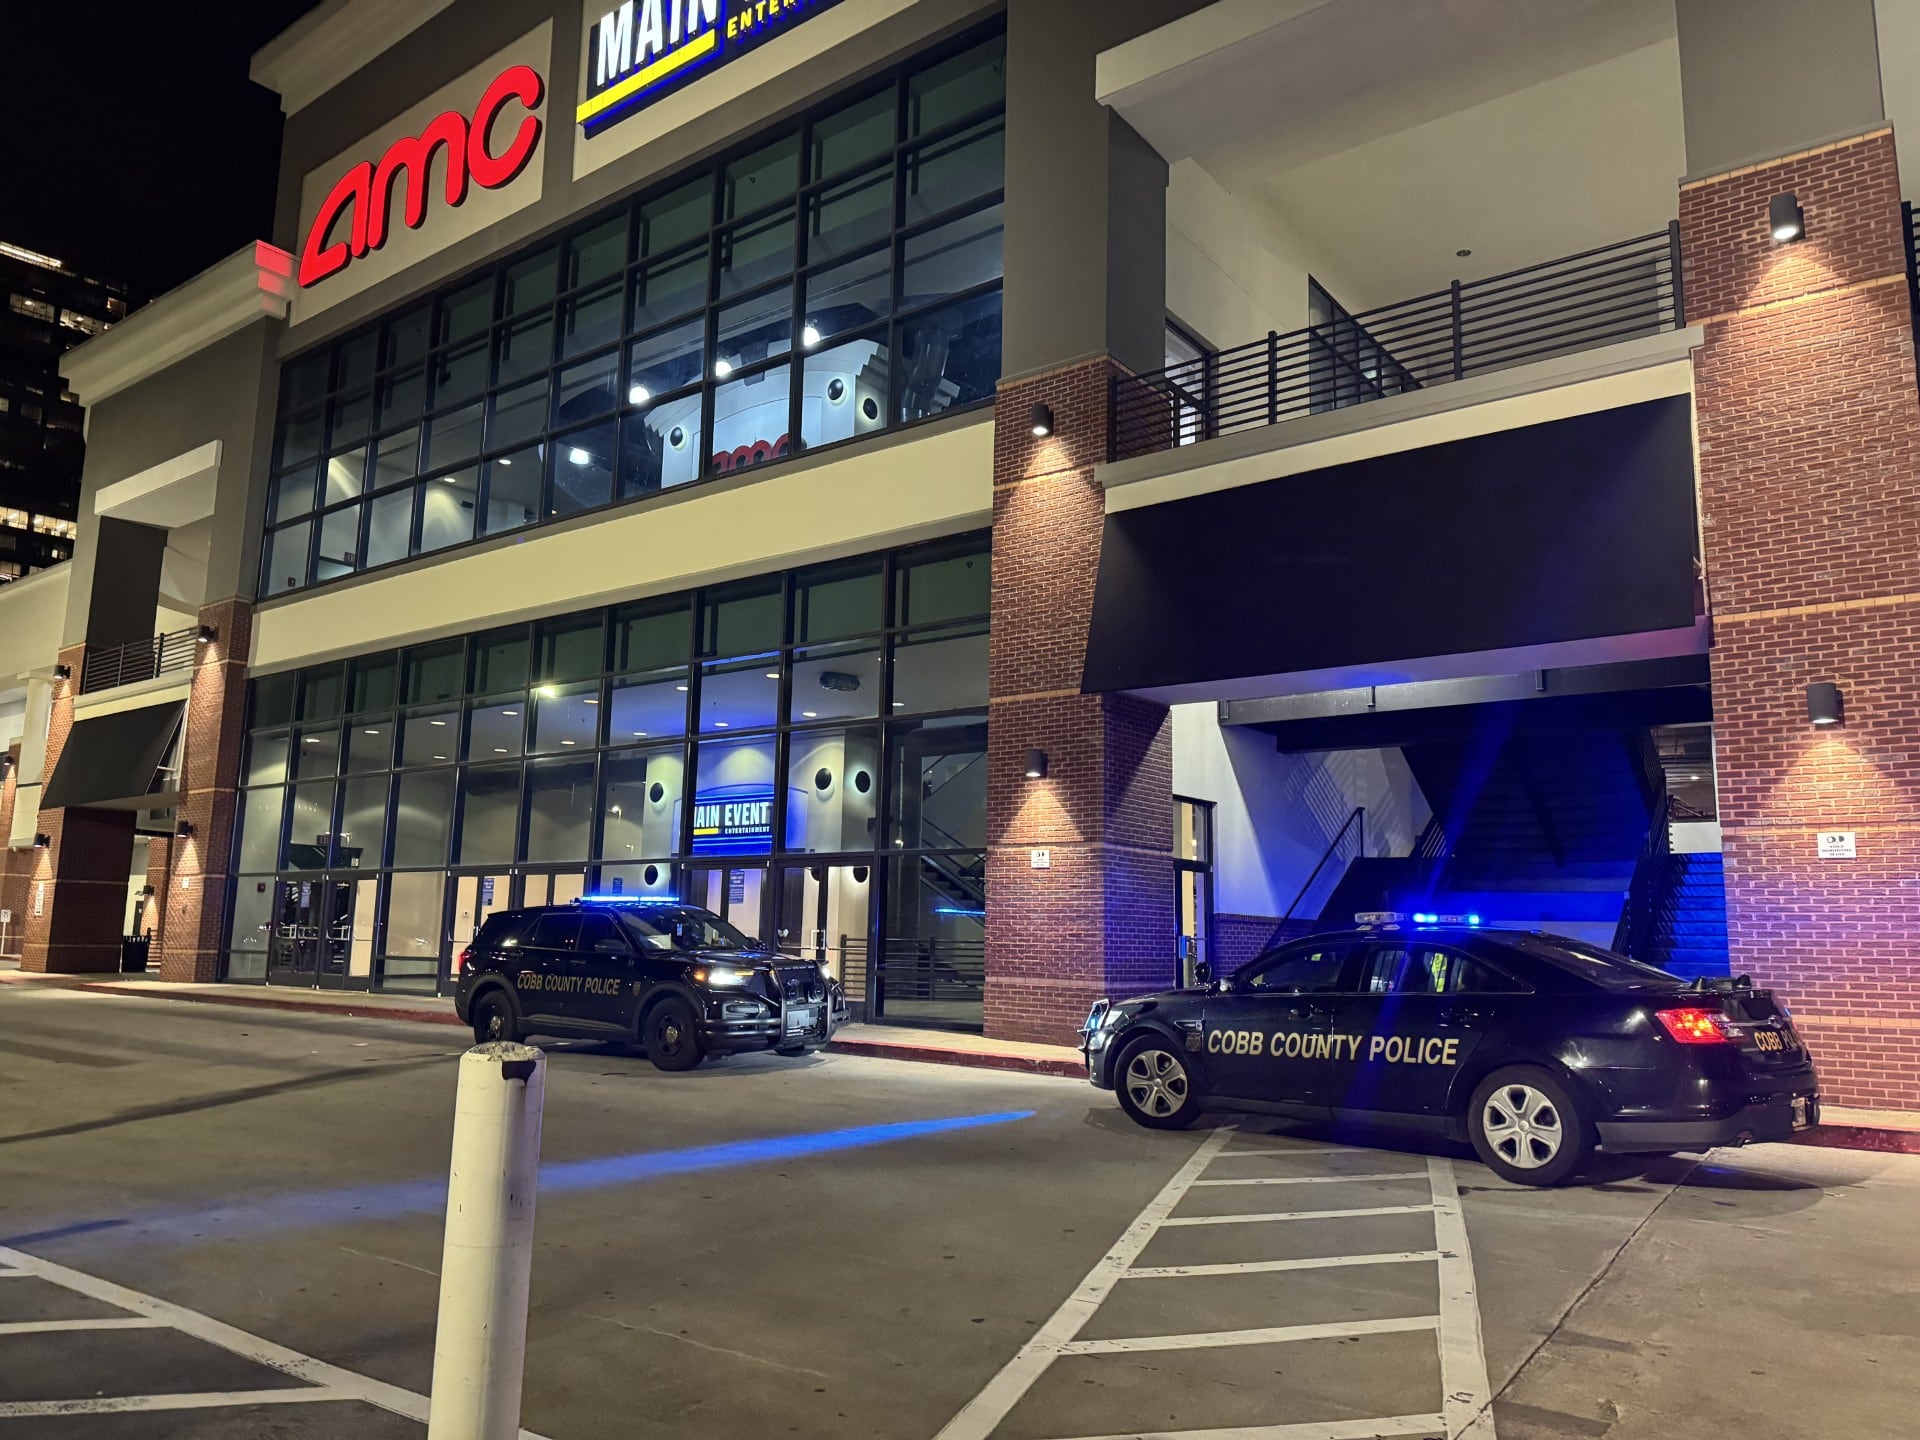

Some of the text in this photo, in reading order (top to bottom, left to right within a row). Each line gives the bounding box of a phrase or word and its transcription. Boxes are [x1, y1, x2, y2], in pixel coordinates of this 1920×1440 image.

[694, 802, 769, 827] AIN EVENT
[517, 974, 620, 994] COBB COUNTY POLICE
[1208, 1030, 1459, 1065] COBB COUNTY POLICE
[1754, 1031, 1783, 1051] COBB
